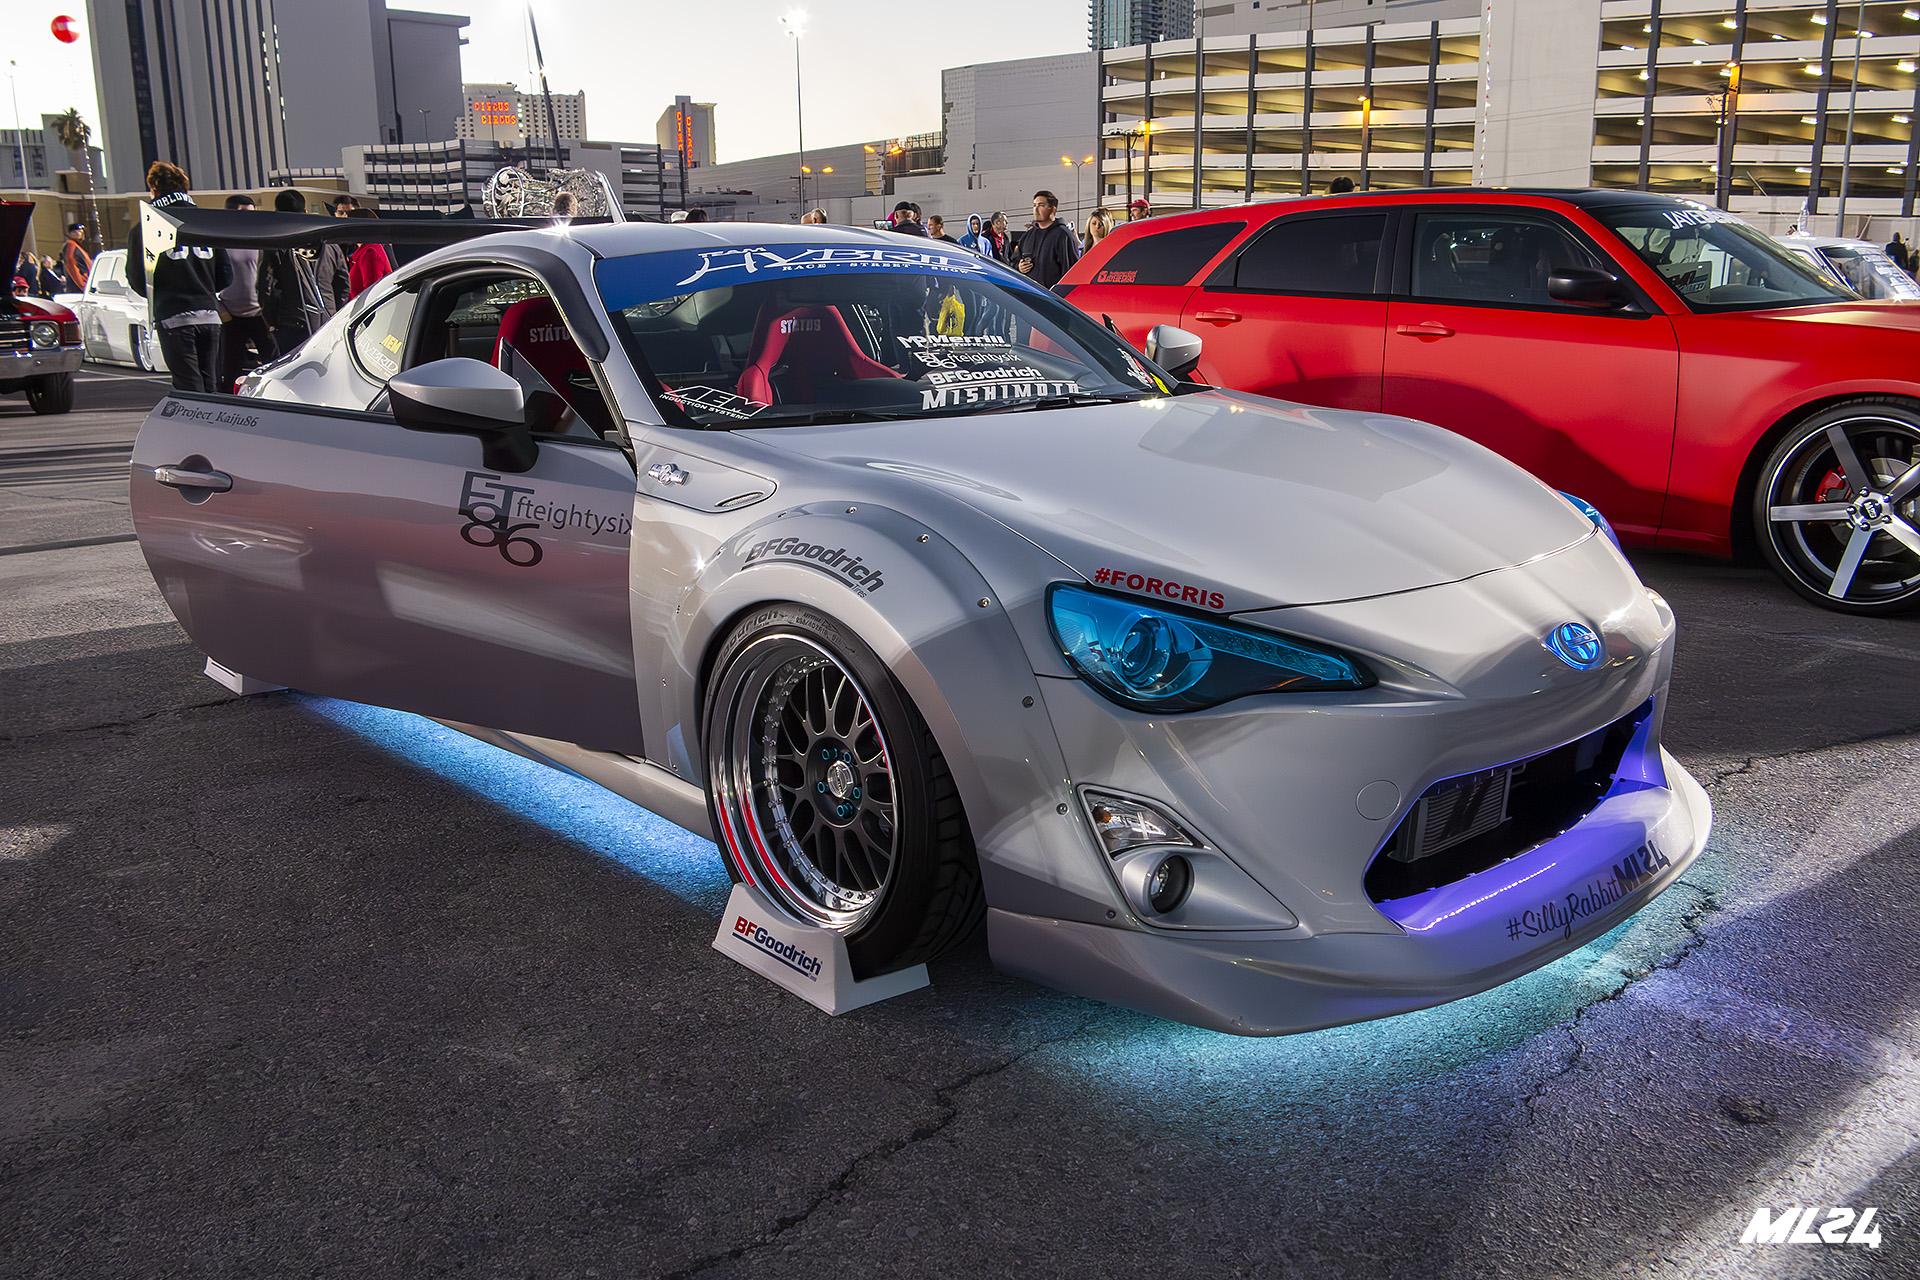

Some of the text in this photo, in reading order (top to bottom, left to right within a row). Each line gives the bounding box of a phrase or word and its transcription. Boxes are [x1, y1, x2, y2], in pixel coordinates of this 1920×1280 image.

[480, 115, 517, 125] CIRCUS
[676, 249, 989, 286] HYBRID
[782, 264, 827, 272] RACE
[529, 323, 570, 343] STÄTU
[928, 335, 1005, 344] Merrill
[927, 366, 1042, 385] BFGoodrich
[659, 394, 707, 410] INDUCTION
[920, 382, 1080, 411] MISHIMOTO
[516, 495, 633, 536] fteightysix
[745, 537, 885, 593] BFGoodrich
[1094, 567, 1225, 609] #FORCRIS
[734, 915, 822, 976] BFGoodrich
